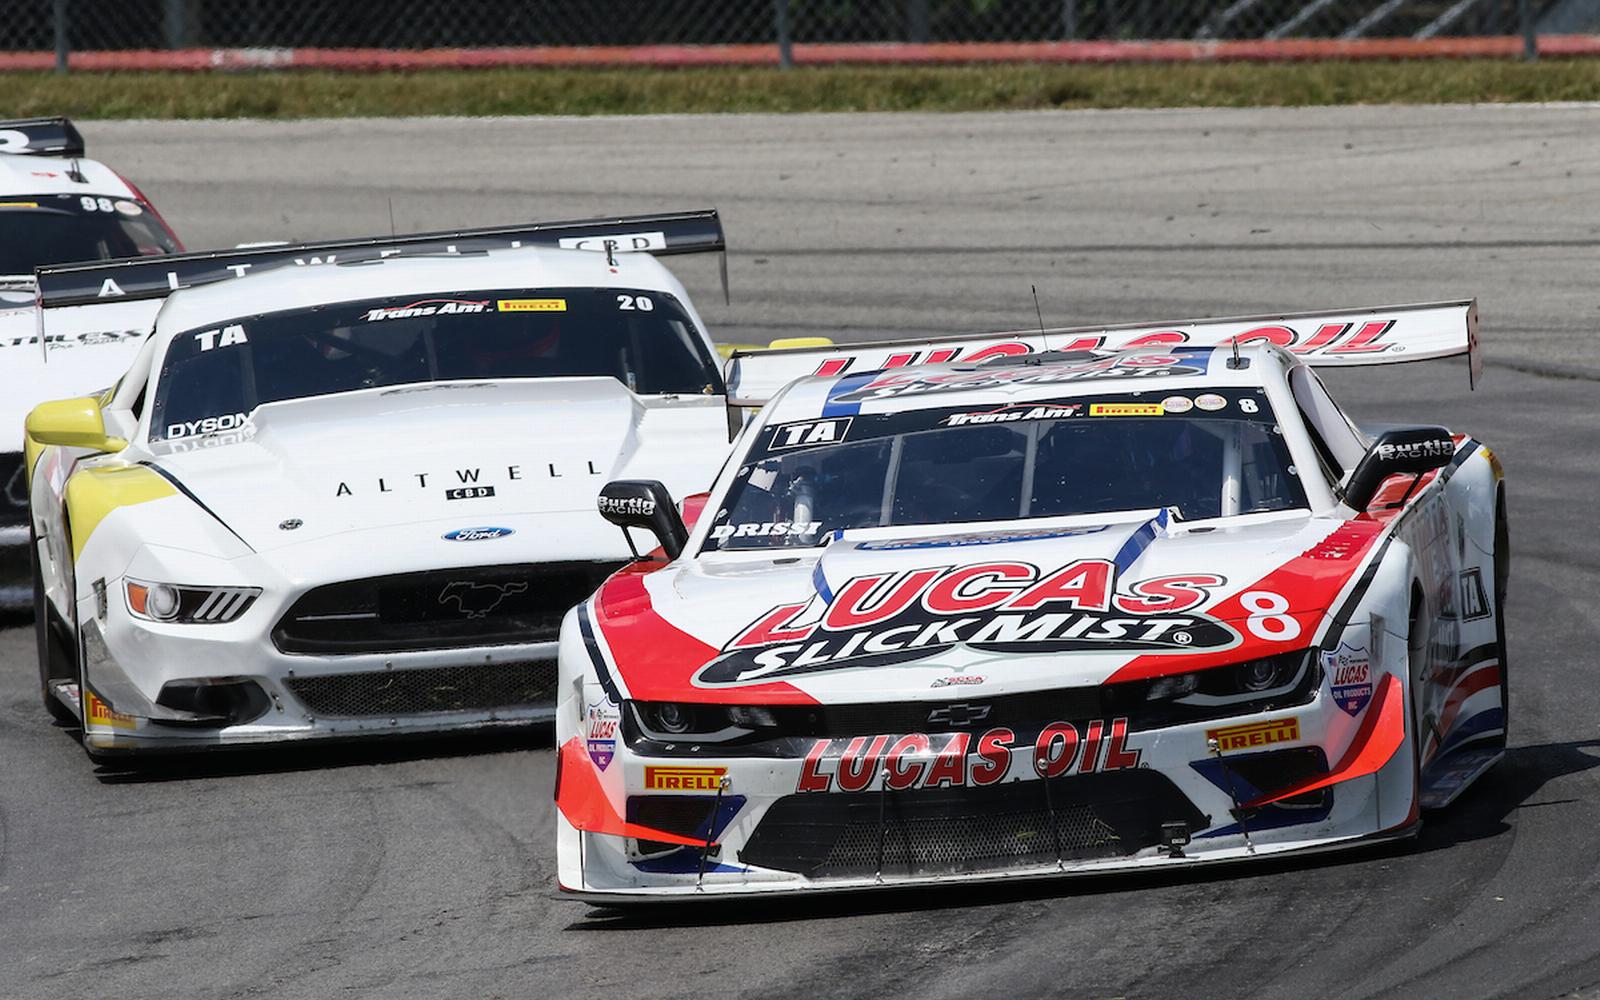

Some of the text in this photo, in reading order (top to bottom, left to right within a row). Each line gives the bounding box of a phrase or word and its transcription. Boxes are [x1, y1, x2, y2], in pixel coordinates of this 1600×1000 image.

[367, 302, 484, 322] Trans Am
[616, 295, 653, 311] 20
[195, 325, 249, 351] TA
[1238, 398, 1259, 414] 8
[167, 412, 253, 439] DYSON
[947, 407, 1075, 426] Trans Am
[784, 422, 836, 445] TA
[1379, 439, 1457, 455] Burtin
[452, 487, 488, 498] CBD
[598, 496, 656, 509] Burtin
[599, 505, 654, 516] RACING
[455, 527, 501, 541] Ford
[709, 521, 823, 539] DRISSI
[720, 558, 1228, 652] LUCAS
[1462, 574, 1483, 617] TA
[1239, 591, 1301, 641] 8
[1334, 663, 1369, 686] LUCAS
[590, 720, 617, 739] LUCAS
[796, 717, 1143, 792] LUCAS OIL
[645, 766, 726, 790] PIRELL
